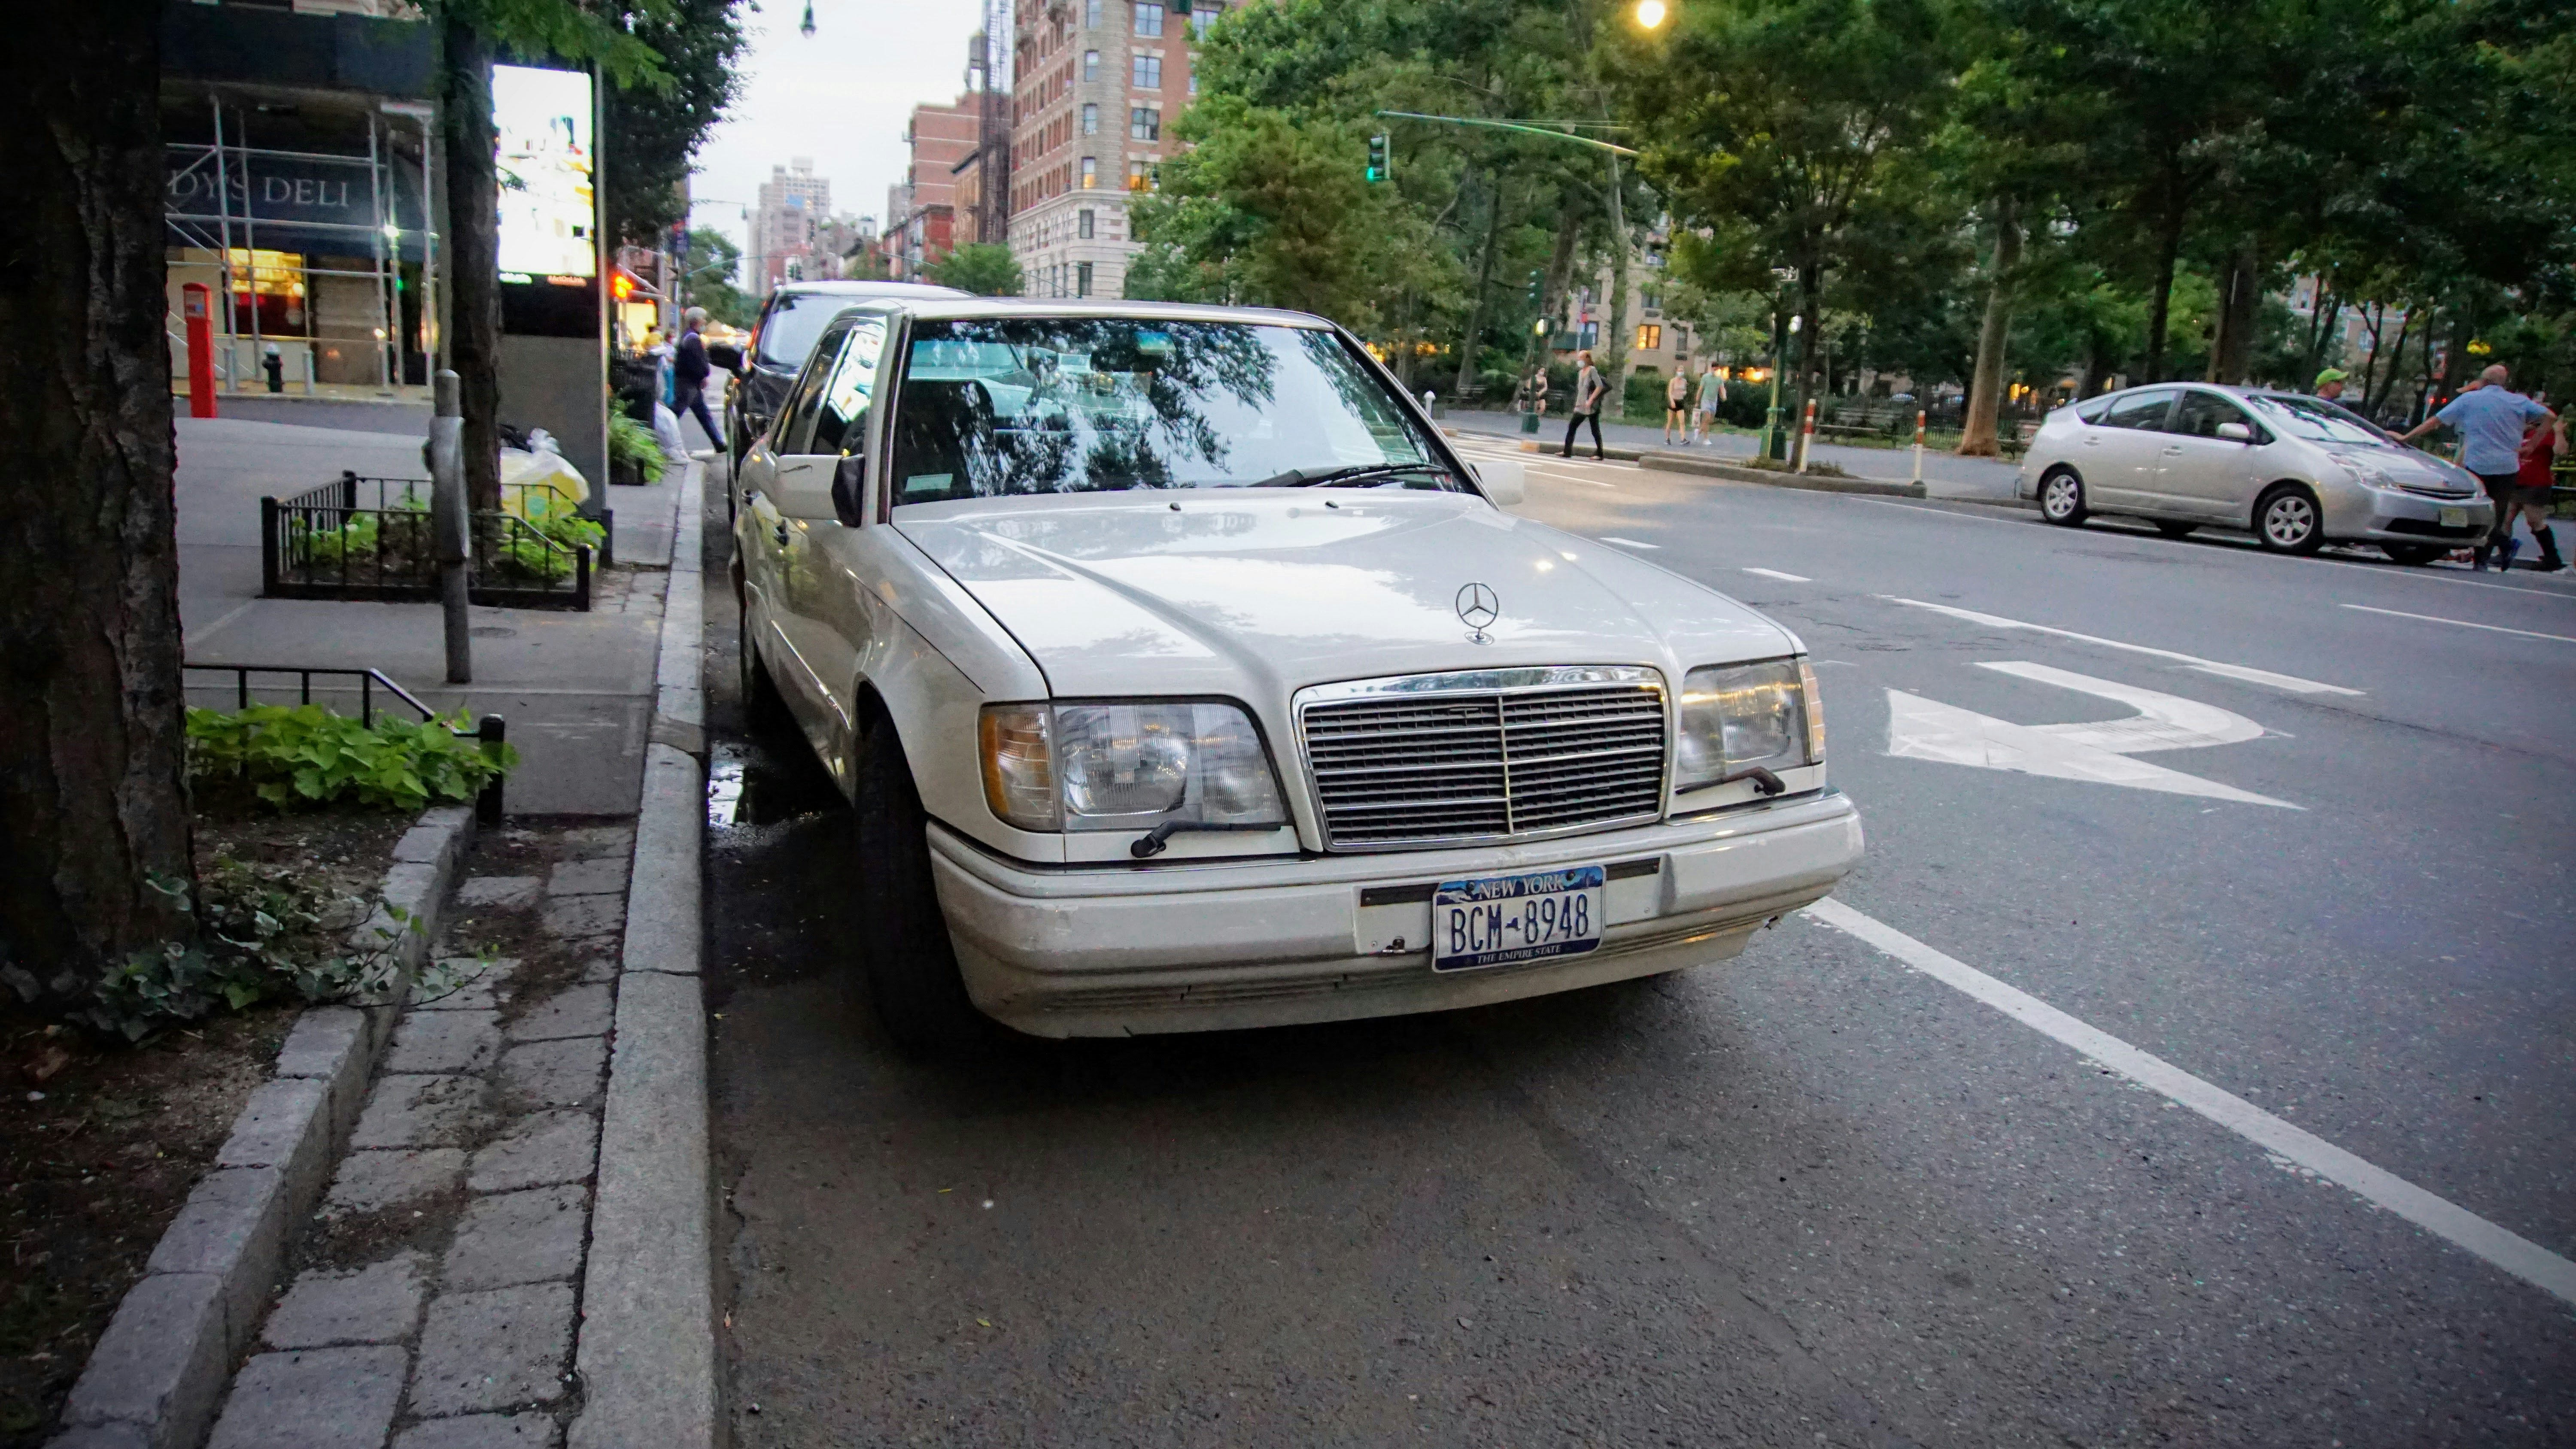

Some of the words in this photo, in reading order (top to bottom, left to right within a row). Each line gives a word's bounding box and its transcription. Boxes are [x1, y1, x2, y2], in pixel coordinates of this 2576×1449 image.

[265, 177, 349, 207] DELI
[1479, 879, 1516, 900] NEW
[1523, 874, 1564, 895] YORK
[1477, 954, 1496, 964] THE
[1499, 949, 1534, 961] EMPIRE
[1535, 945, 1561, 956] STATE
